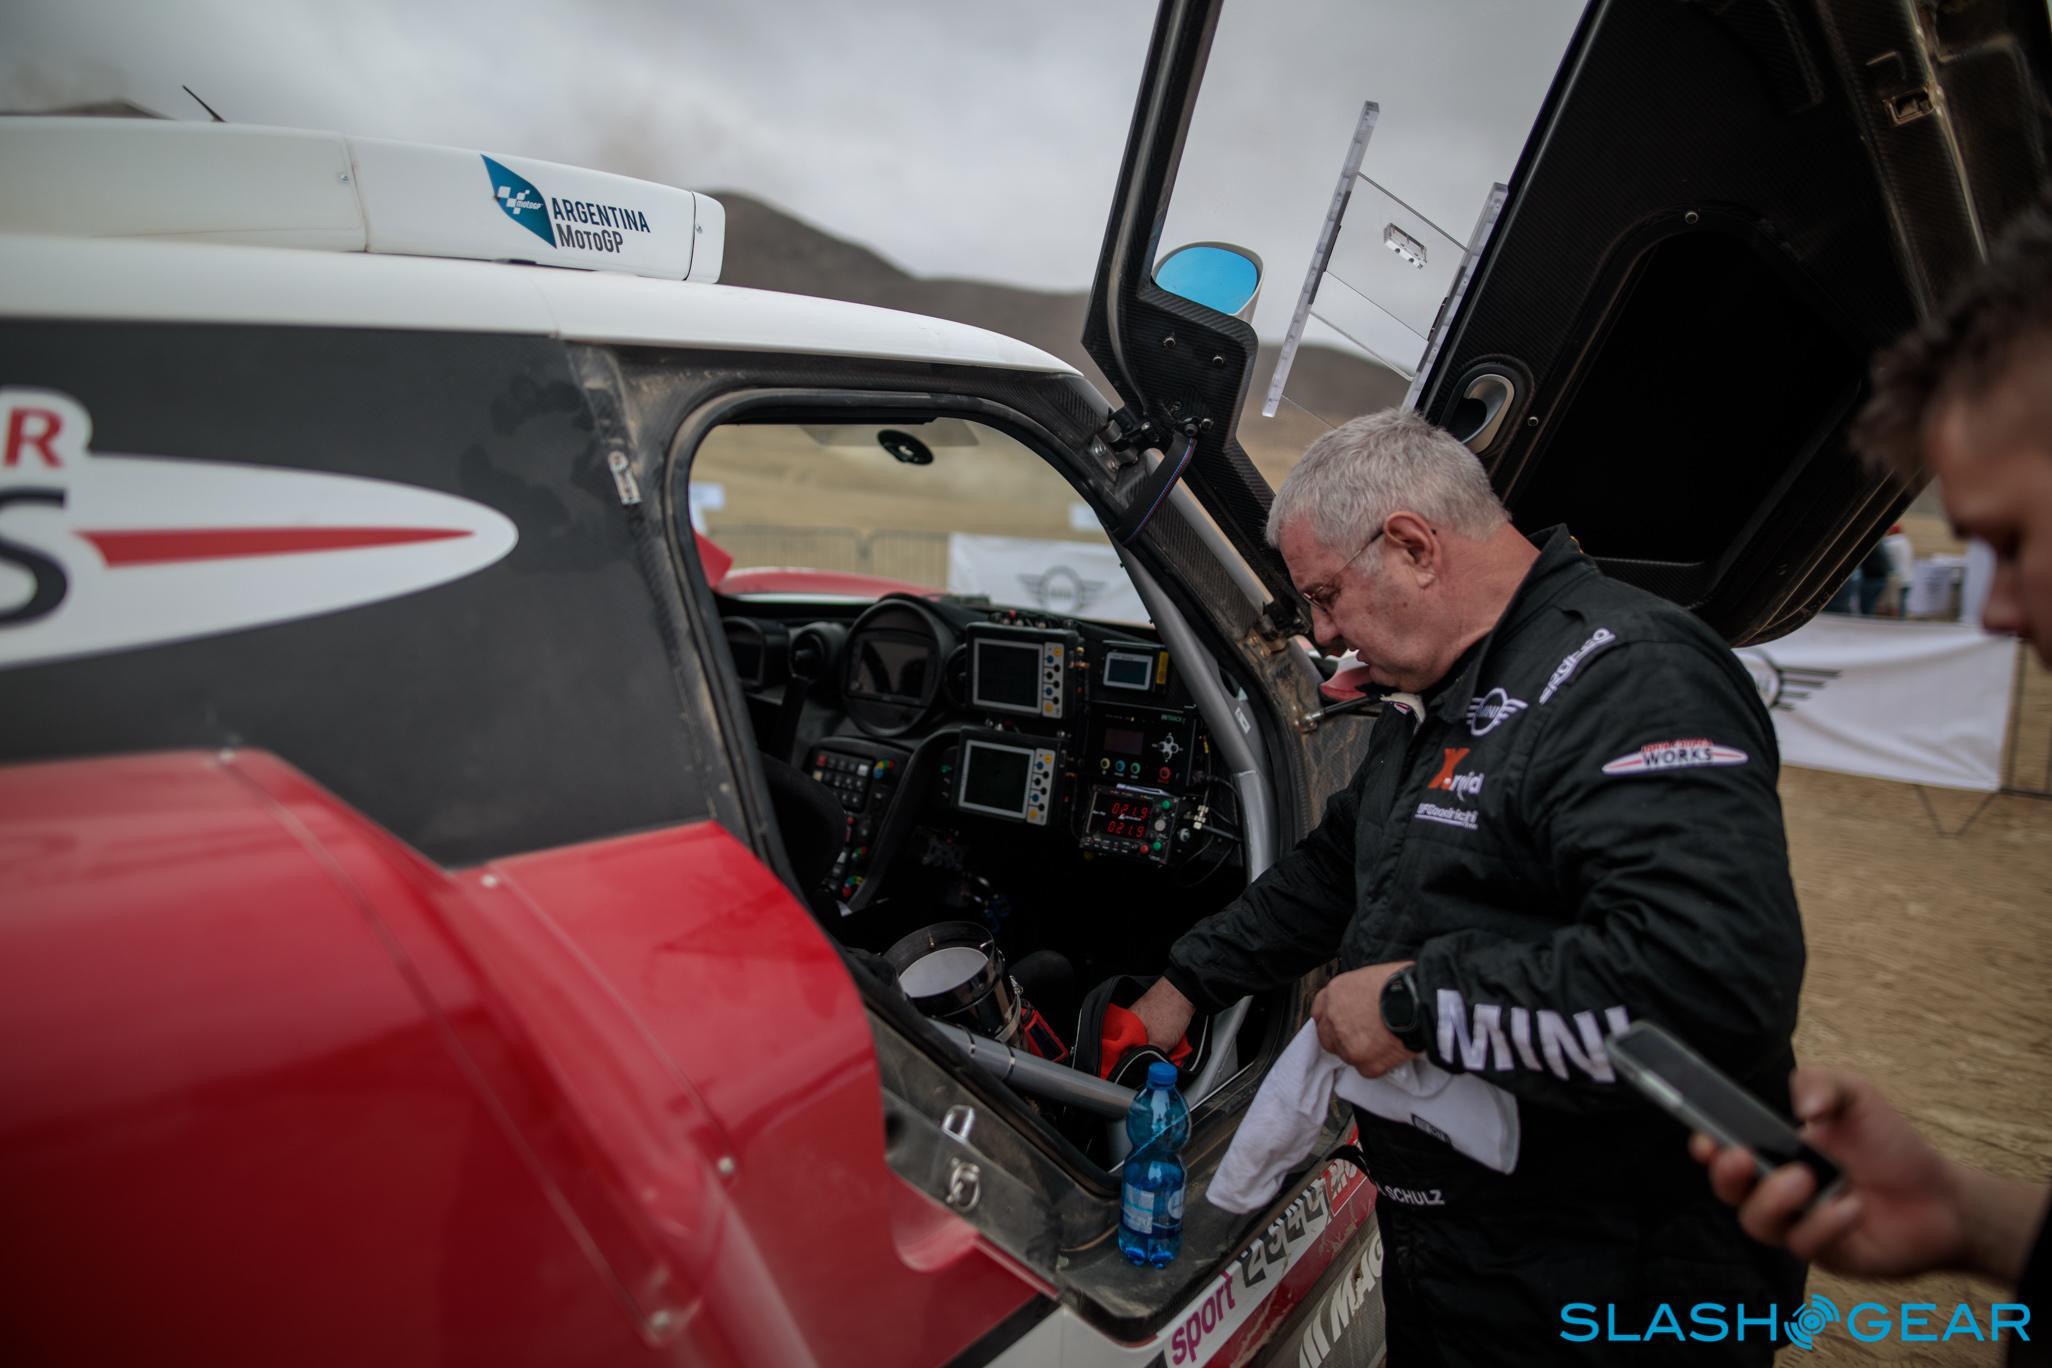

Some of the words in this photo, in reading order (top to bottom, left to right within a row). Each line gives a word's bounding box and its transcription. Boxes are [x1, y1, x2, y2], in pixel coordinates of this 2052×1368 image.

[551, 197, 651, 233] ARGENTINA
[1642, 747, 1713, 766] WORKS
[1384, 1185, 1445, 1206] SCHULZ
[1171, 1270, 1236, 1366] sport
